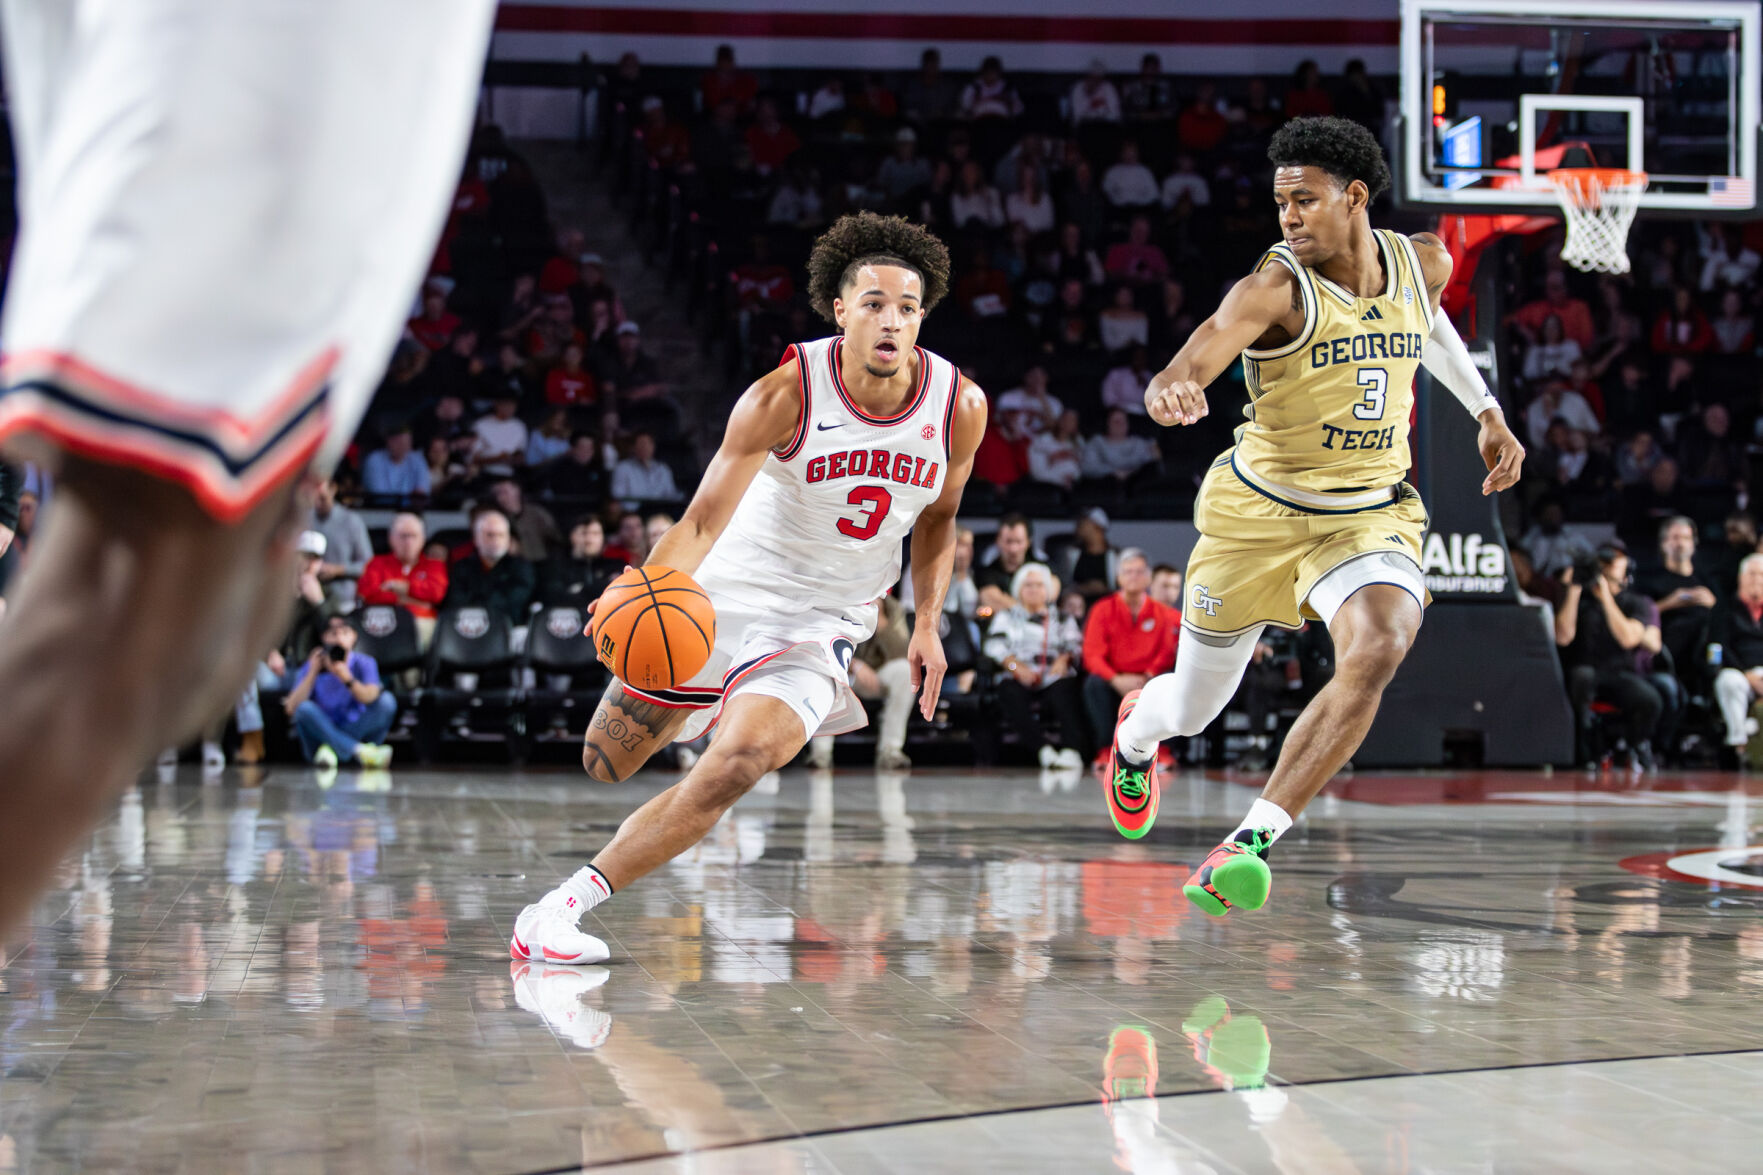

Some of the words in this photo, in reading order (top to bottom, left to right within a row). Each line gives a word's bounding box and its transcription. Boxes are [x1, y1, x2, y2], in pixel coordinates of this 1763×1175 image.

[1311, 332, 1423, 369] GEORGIA
[1352, 367, 1389, 420] 3
[1321, 423, 1396, 451] TECH
[806, 449, 939, 489] GEORGIA
[836, 485, 893, 541] 3
[1422, 532, 1505, 577] Alfa
[1423, 575, 1504, 593] nsurance
